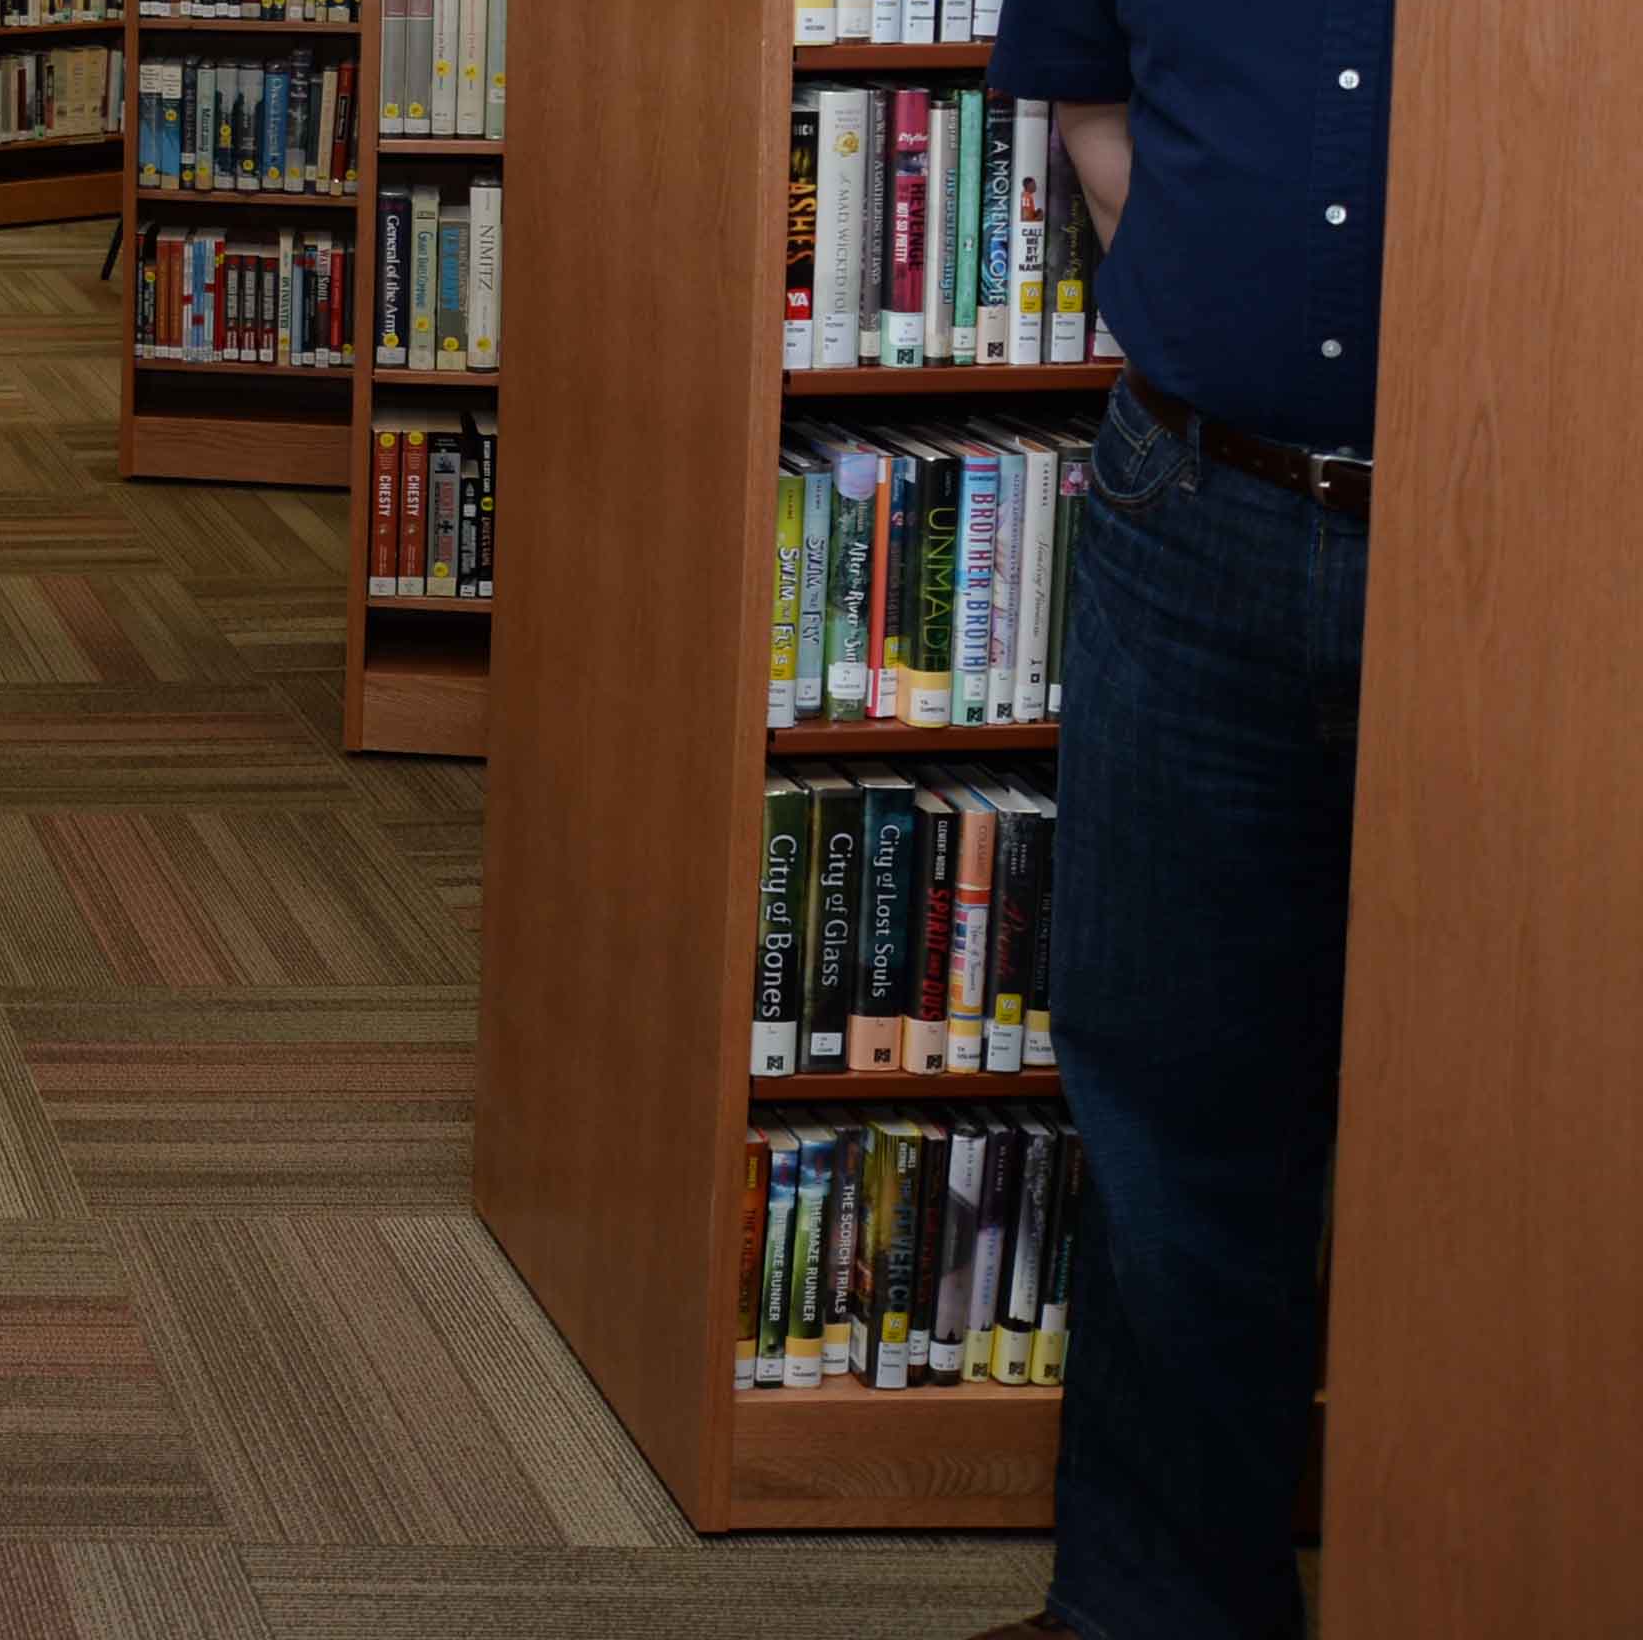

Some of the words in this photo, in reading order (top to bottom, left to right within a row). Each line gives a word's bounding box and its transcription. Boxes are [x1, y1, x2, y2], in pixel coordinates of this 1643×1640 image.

[993, 140, 1007, 153] A
[785, 182, 818, 266] ASHES
[835, 189, 851, 223] MAD
[871, 170, 883, 235] GATHERING
[991, 159, 1009, 244] MOMENT
[386, 215, 400, 263] General
[908, 183, 925, 271] REVENGE
[1021, 228, 1043, 237] CALL
[386, 265, 401, 279] of
[480, 225, 494, 290] NIMITZ
[835, 227, 850, 287] WICKED
[990, 250, 1007, 302] COME
[1018, 263, 1044, 272] NAME
[386, 282, 400, 302] the
[788, 292, 809, 307] YA
[379, 475, 392, 517] CHESTY
[407, 474, 419, 516] CHESTY
[805, 536, 825, 589] SWIM
[848, 542, 868, 574] After
[965, 494, 996, 597] BROTHER,
[779, 546, 798, 600] SWIM
[923, 506, 956, 674] UNMADE
[803, 611, 824, 646] FLY
[847, 591, 863, 627] River
[962, 600, 988, 672] BROTH
[761, 834, 798, 893] City
[820, 833, 854, 887] City
[873, 824, 901, 869] City
[934, 820, 948, 881] CLEMENT-MOORE
[825, 894, 848, 916] of
[876, 872, 897, 890] of
[766, 902, 792, 925] of
[875, 893, 898, 937] Lost
[926, 887, 951, 952] SPIRIT
[762, 932, 793, 1018] Bones
[821, 919, 849, 987] Glass
[872, 943, 895, 998] Souls
[921, 977, 946, 1020] DUS
[808, 1199, 822, 1223] THE
[841, 1183, 855, 1209] THE
[806, 1226, 821, 1263] MAZE
[837, 1214, 854, 1265] SCORCH
[888, 1206, 915, 1279] FEVER
[769, 1270, 784, 1322] RUNNER
[802, 1267, 818, 1322] RUNNER
[834, 1268, 849, 1314] TRIALS
